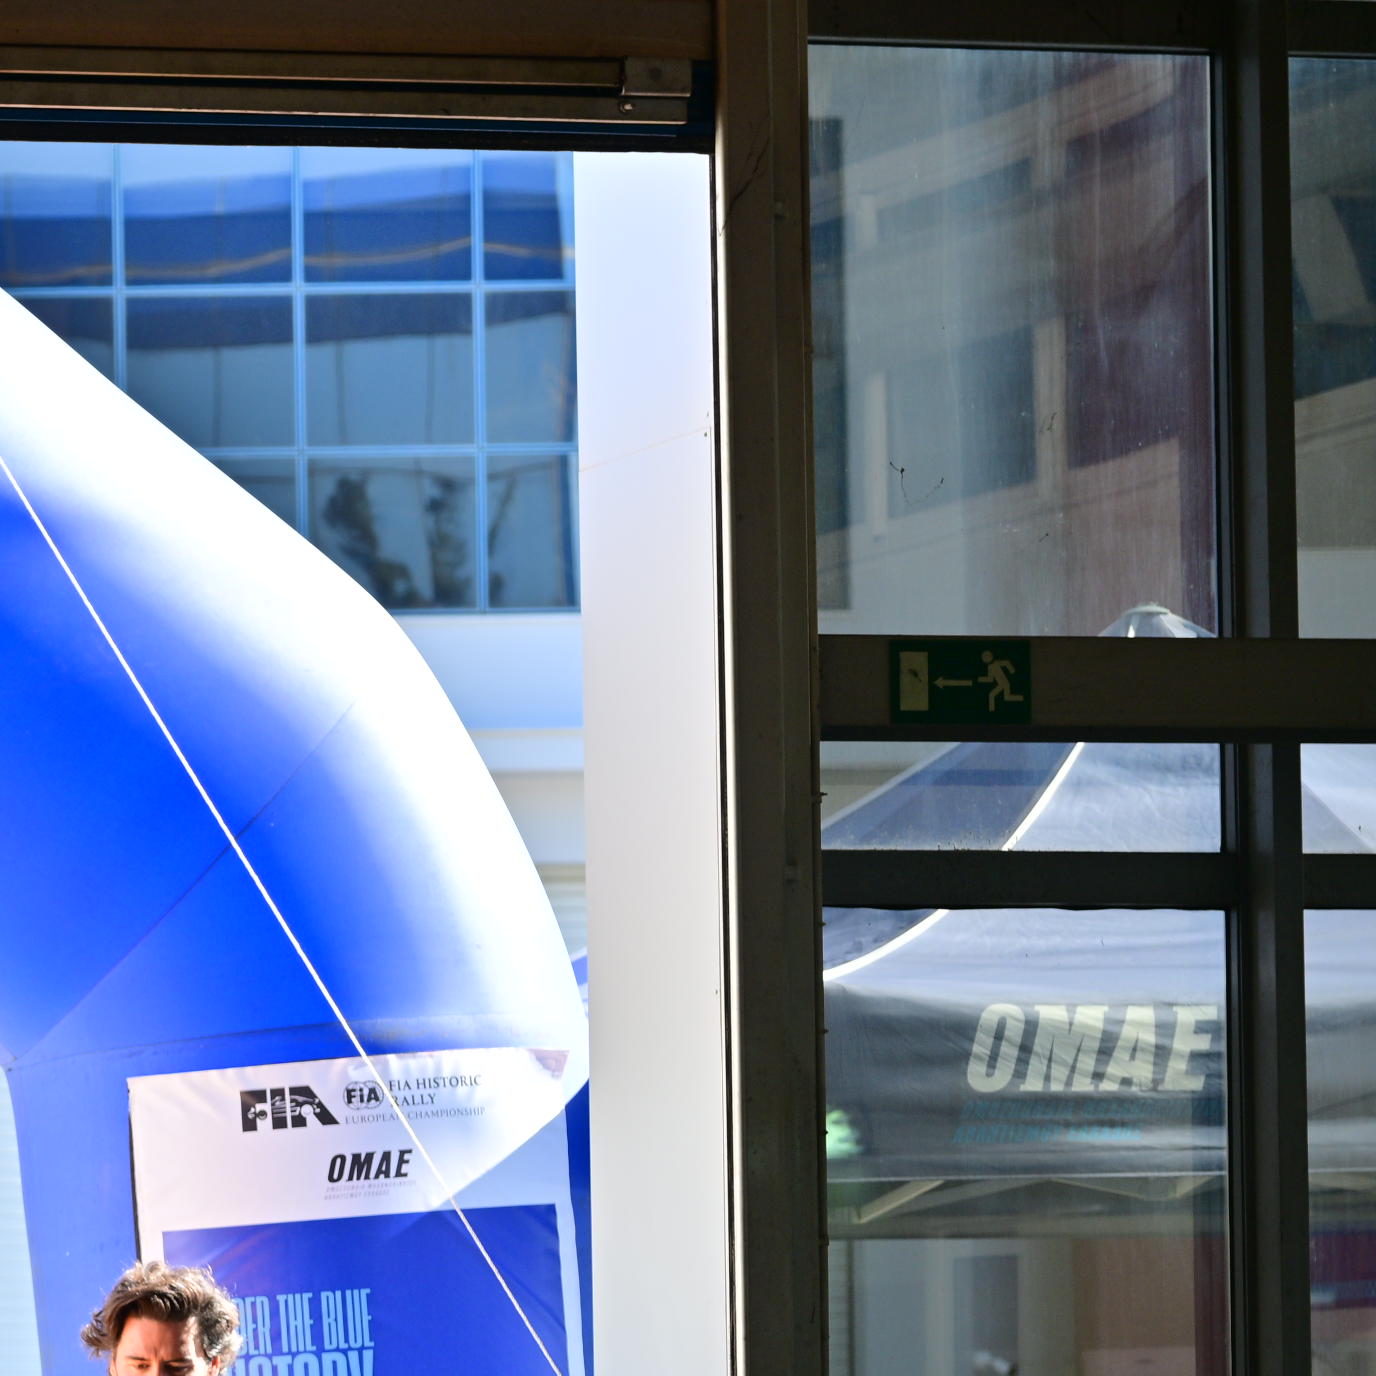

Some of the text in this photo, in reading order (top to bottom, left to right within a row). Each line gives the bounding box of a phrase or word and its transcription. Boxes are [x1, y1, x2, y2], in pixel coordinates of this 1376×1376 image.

[967, 1003, 1218, 1093] OMAE
[389, 1074, 482, 1092] FIA HISTORIC
[240, 1086, 340, 1132] FIA
[407, 1107, 486, 1121] CHAMPIONSHIP
[327, 1149, 413, 1183] OMAE
[276, 1292, 317, 1353] THE
[320, 1288, 375, 1350] BLUE
